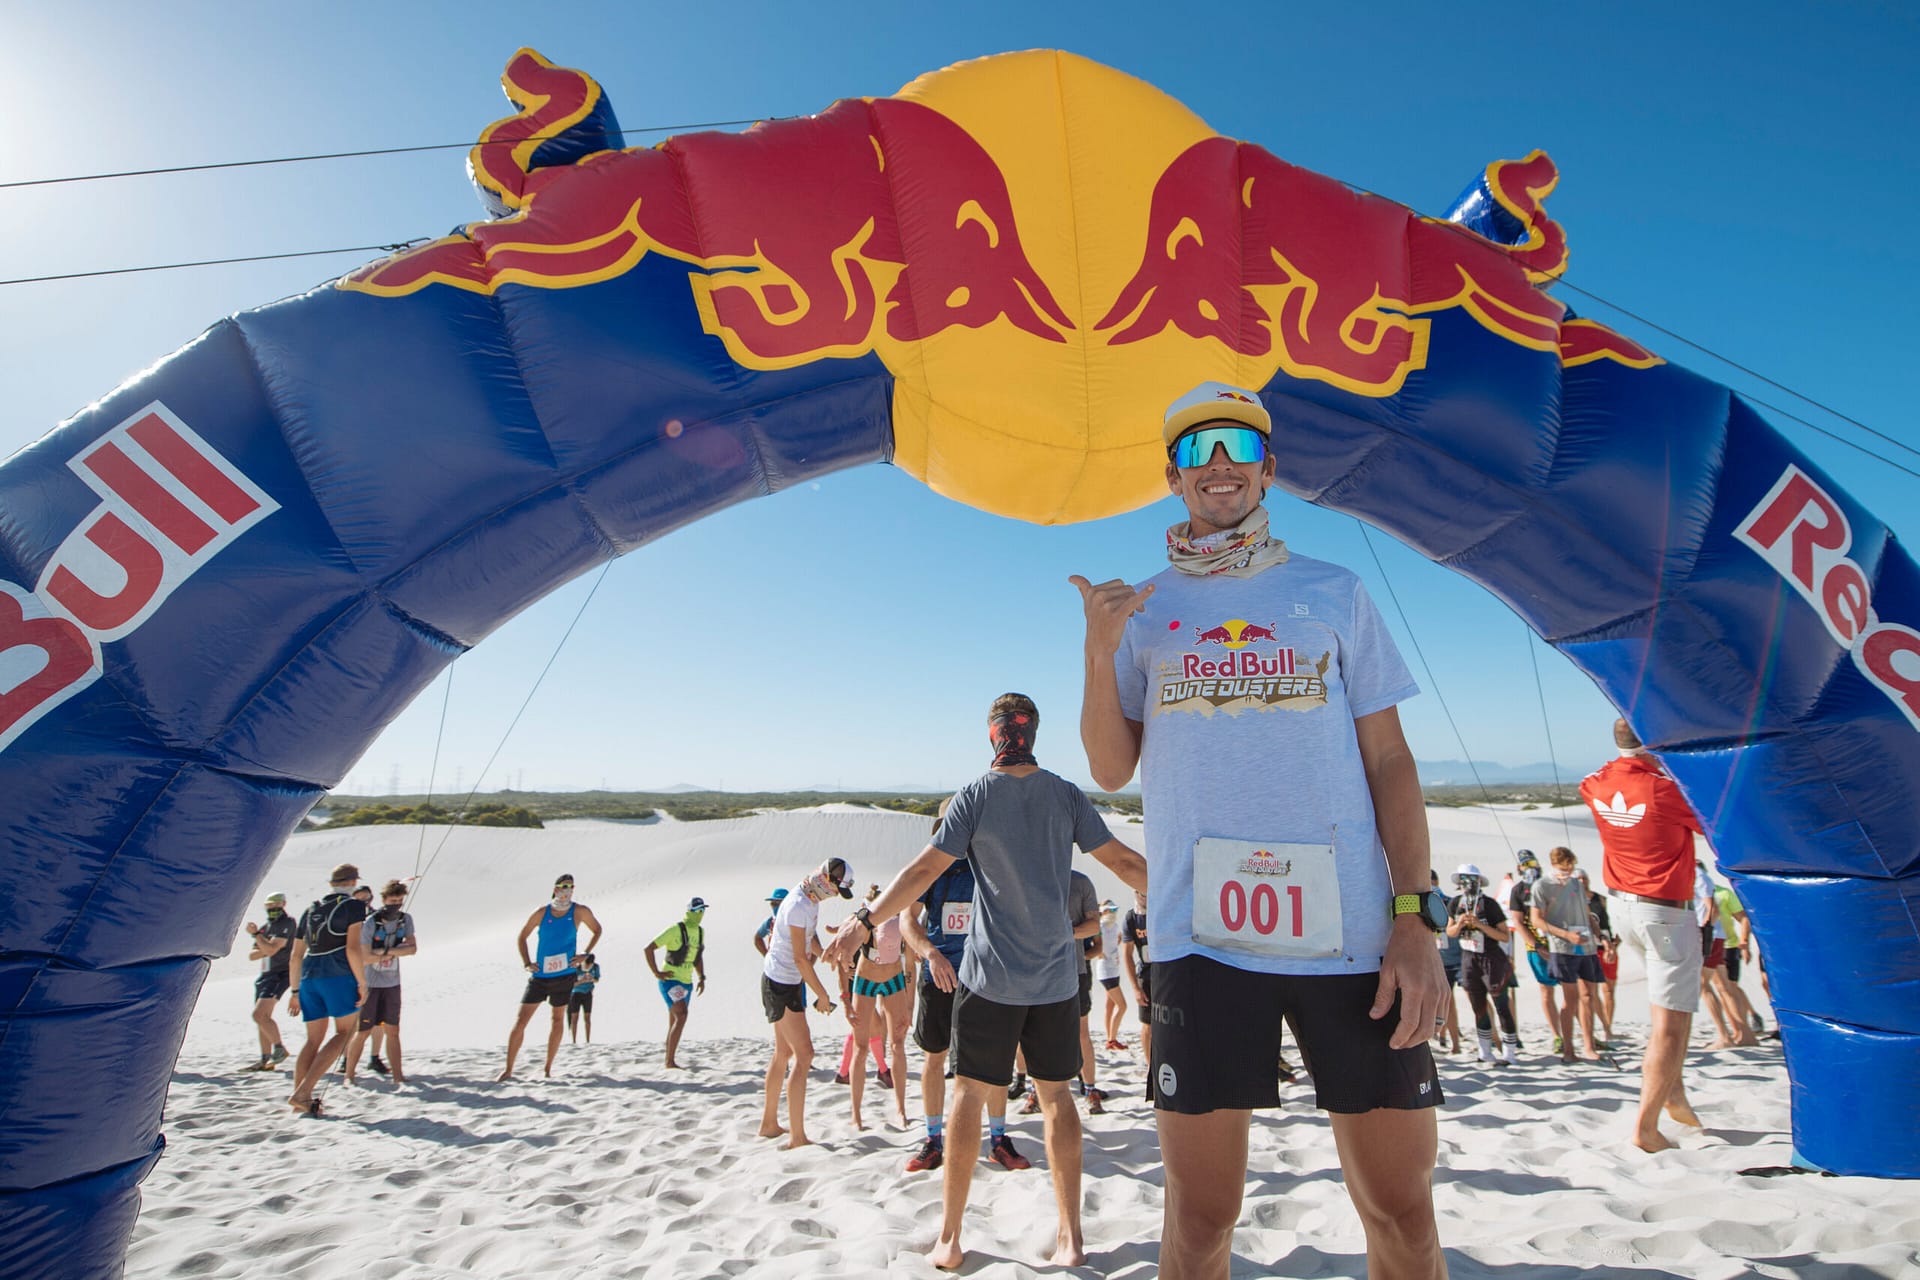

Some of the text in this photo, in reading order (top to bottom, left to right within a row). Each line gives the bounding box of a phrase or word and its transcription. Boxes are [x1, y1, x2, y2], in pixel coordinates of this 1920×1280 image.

[1183, 648, 1295, 679] Red Bull
[1218, 677, 1325, 698] DUSTERS
[1248, 859, 1279, 869] Red Bull
[1220, 880, 1303, 938] 001
